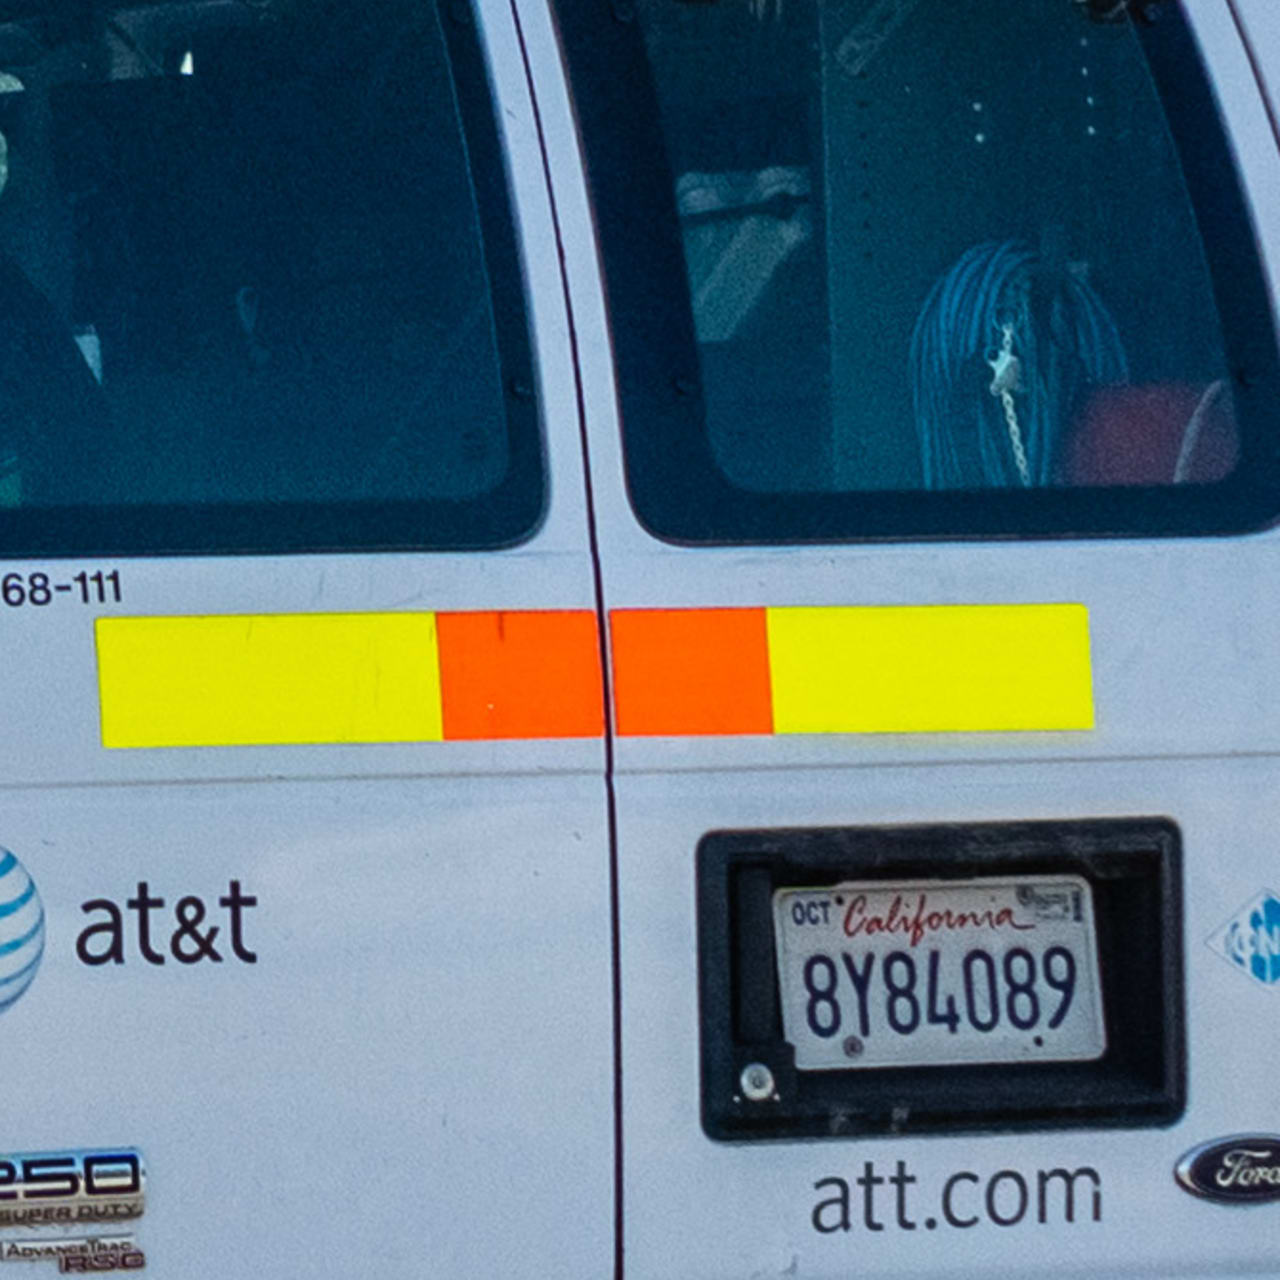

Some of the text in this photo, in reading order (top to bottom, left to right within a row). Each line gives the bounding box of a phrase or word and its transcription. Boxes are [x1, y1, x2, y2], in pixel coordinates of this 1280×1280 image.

[75, 879, 258, 966] at&t
[792, 900, 831, 926] OCT
[843, 893, 1036, 947] California
[803, 946, 1077, 1039] 8Y84089
[77, 1202, 139, 1221] DUTY
[810, 1160, 1102, 1234] att.com
